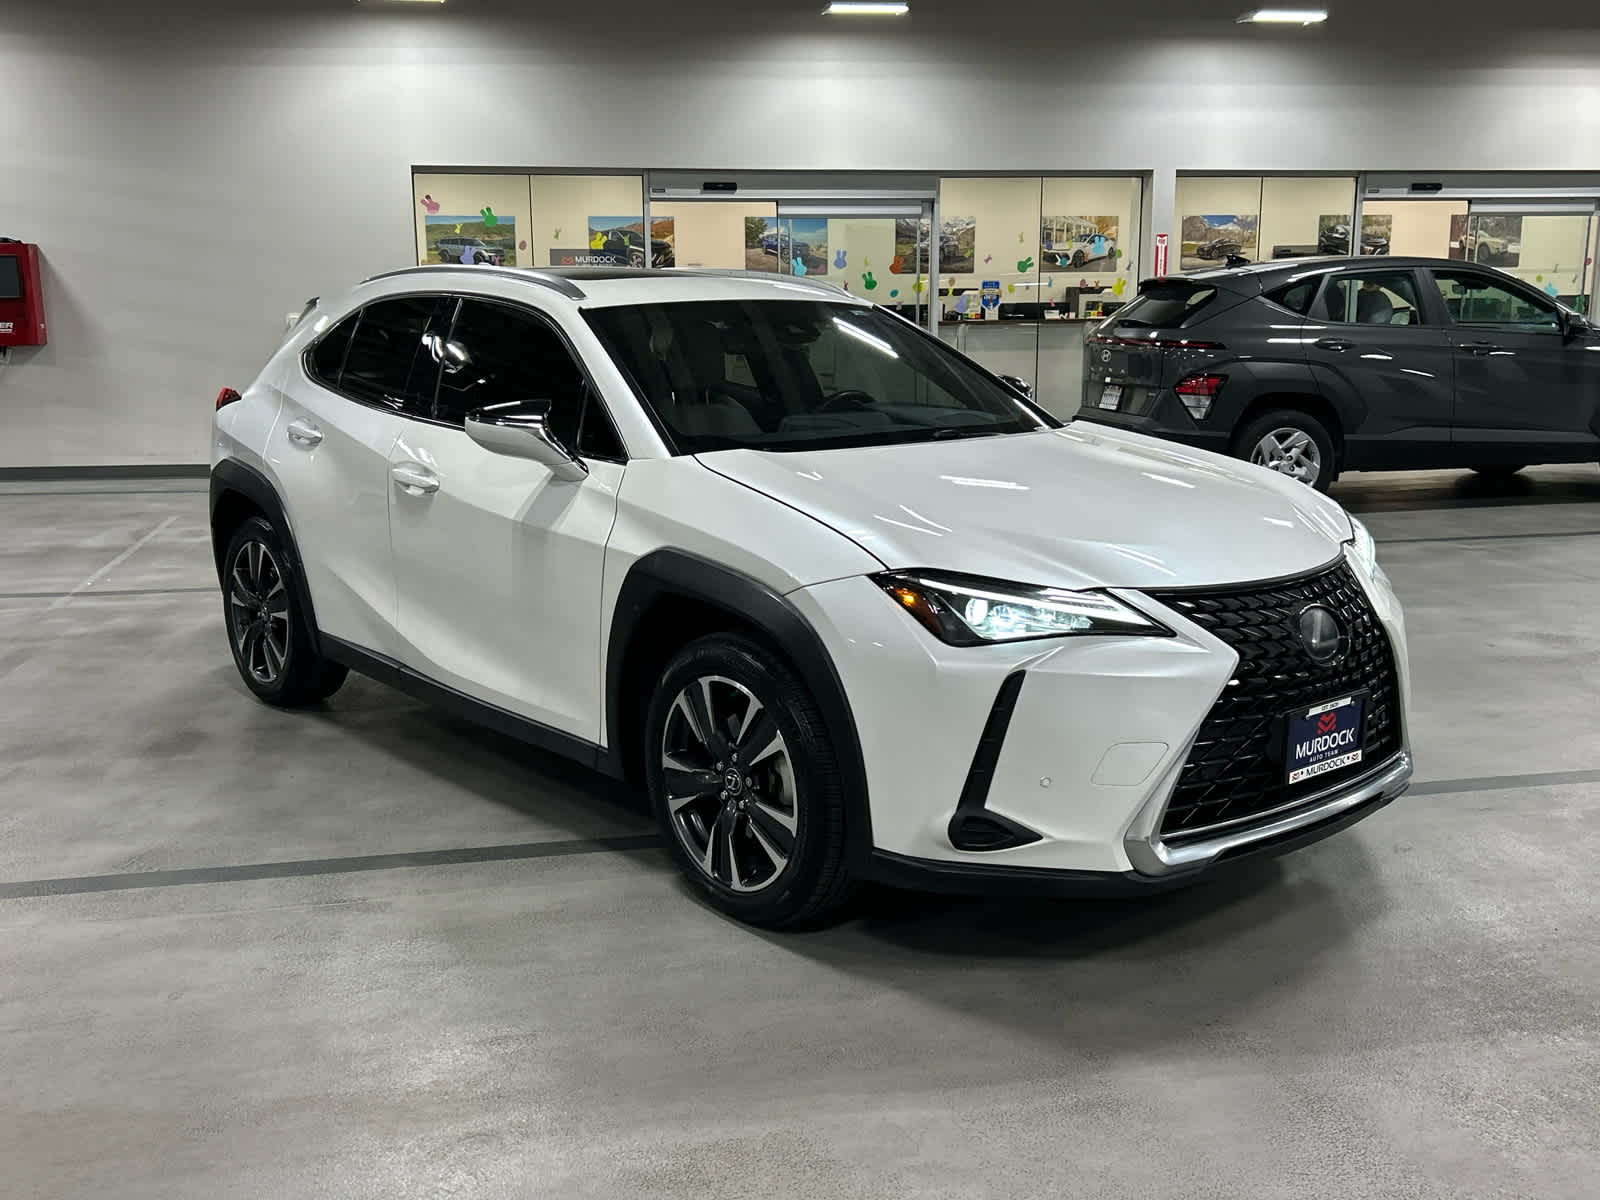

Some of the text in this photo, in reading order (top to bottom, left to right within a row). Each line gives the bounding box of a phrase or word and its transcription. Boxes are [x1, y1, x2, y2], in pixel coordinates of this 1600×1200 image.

[575, 256, 616, 264] MURDOCK
[1295, 728, 1355, 759] MURDOCK
[1309, 753, 1323, 762] AUTO
[1306, 757, 1345, 776] MURDOCK
